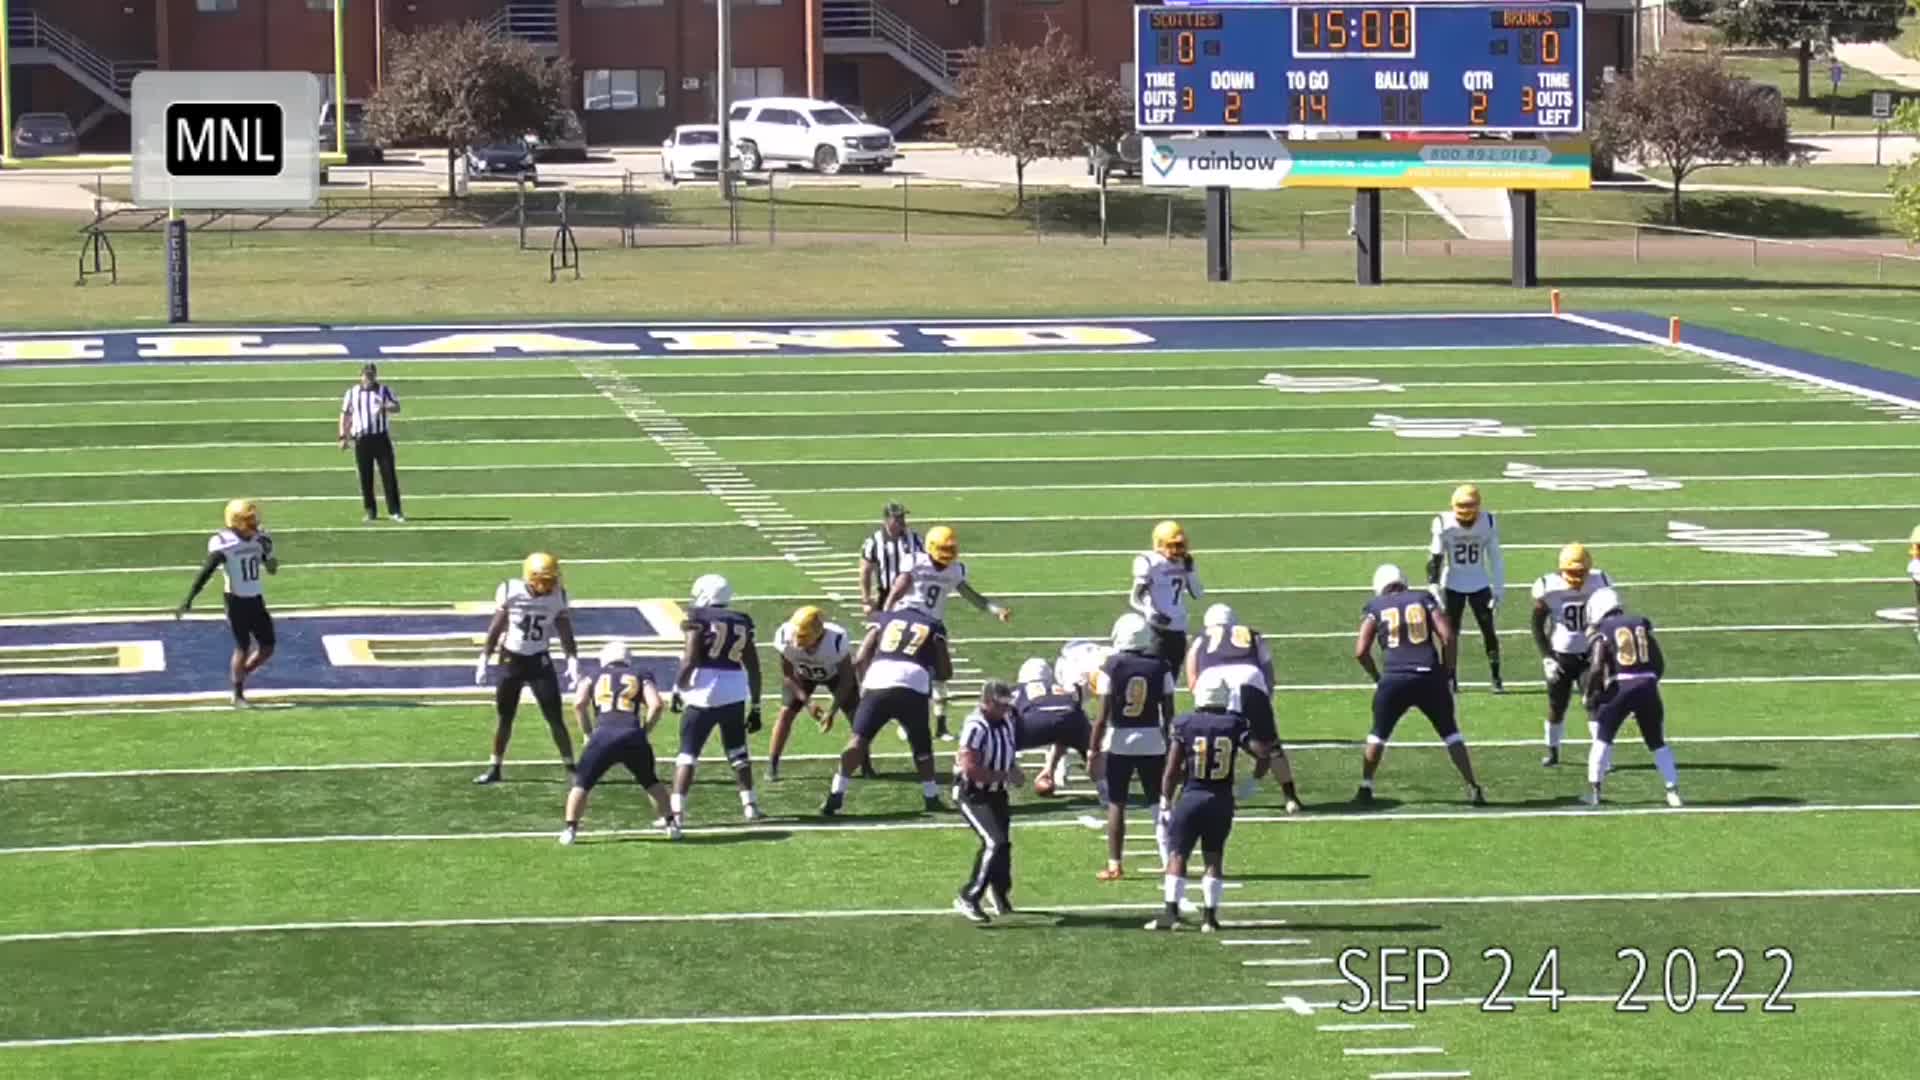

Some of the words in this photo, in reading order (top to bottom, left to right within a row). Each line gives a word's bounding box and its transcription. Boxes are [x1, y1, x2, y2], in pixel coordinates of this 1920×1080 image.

[1152, 12, 1217, 28] SCOTTIES
[1312, 10, 1410, 48] 15:00
[1177, 31, 1194, 64] 0
[1541, 31, 1559, 64] 0
[1144, 72, 1176, 88] TIME
[1211, 71, 1255, 89] DOWN
[1286, 71, 1306, 89] TO
[1309, 71, 1329, 89] GO
[1375, 71, 1408, 89] BALL
[1409, 71, 1429, 89] ON
[1462, 71, 1493, 91] QTR
[1537, 72, 1570, 88] TIME
[1143, 90, 1177, 106] OUTS
[1182, 86, 1194, 111] 3
[1224, 92, 1242, 123] 2
[1299, 94, 1328, 121] 14
[1471, 92, 1488, 124] 2
[1521, 86, 1535, 112] 3
[1536, 91, 1573, 107] OUTS
[1144, 109, 1175, 124] LEFT
[1538, 109, 1571, 125] LEFT
[1187, 150, 1277, 170] rainbow
[1453, 544, 1480, 565] 26
[240, 556, 260, 583] 10
[1170, 577, 1184, 606] 7
[593, 673, 639, 713] 42
[1123, 676, 1148, 717] 9
[1192, 736, 1233, 780] 13
